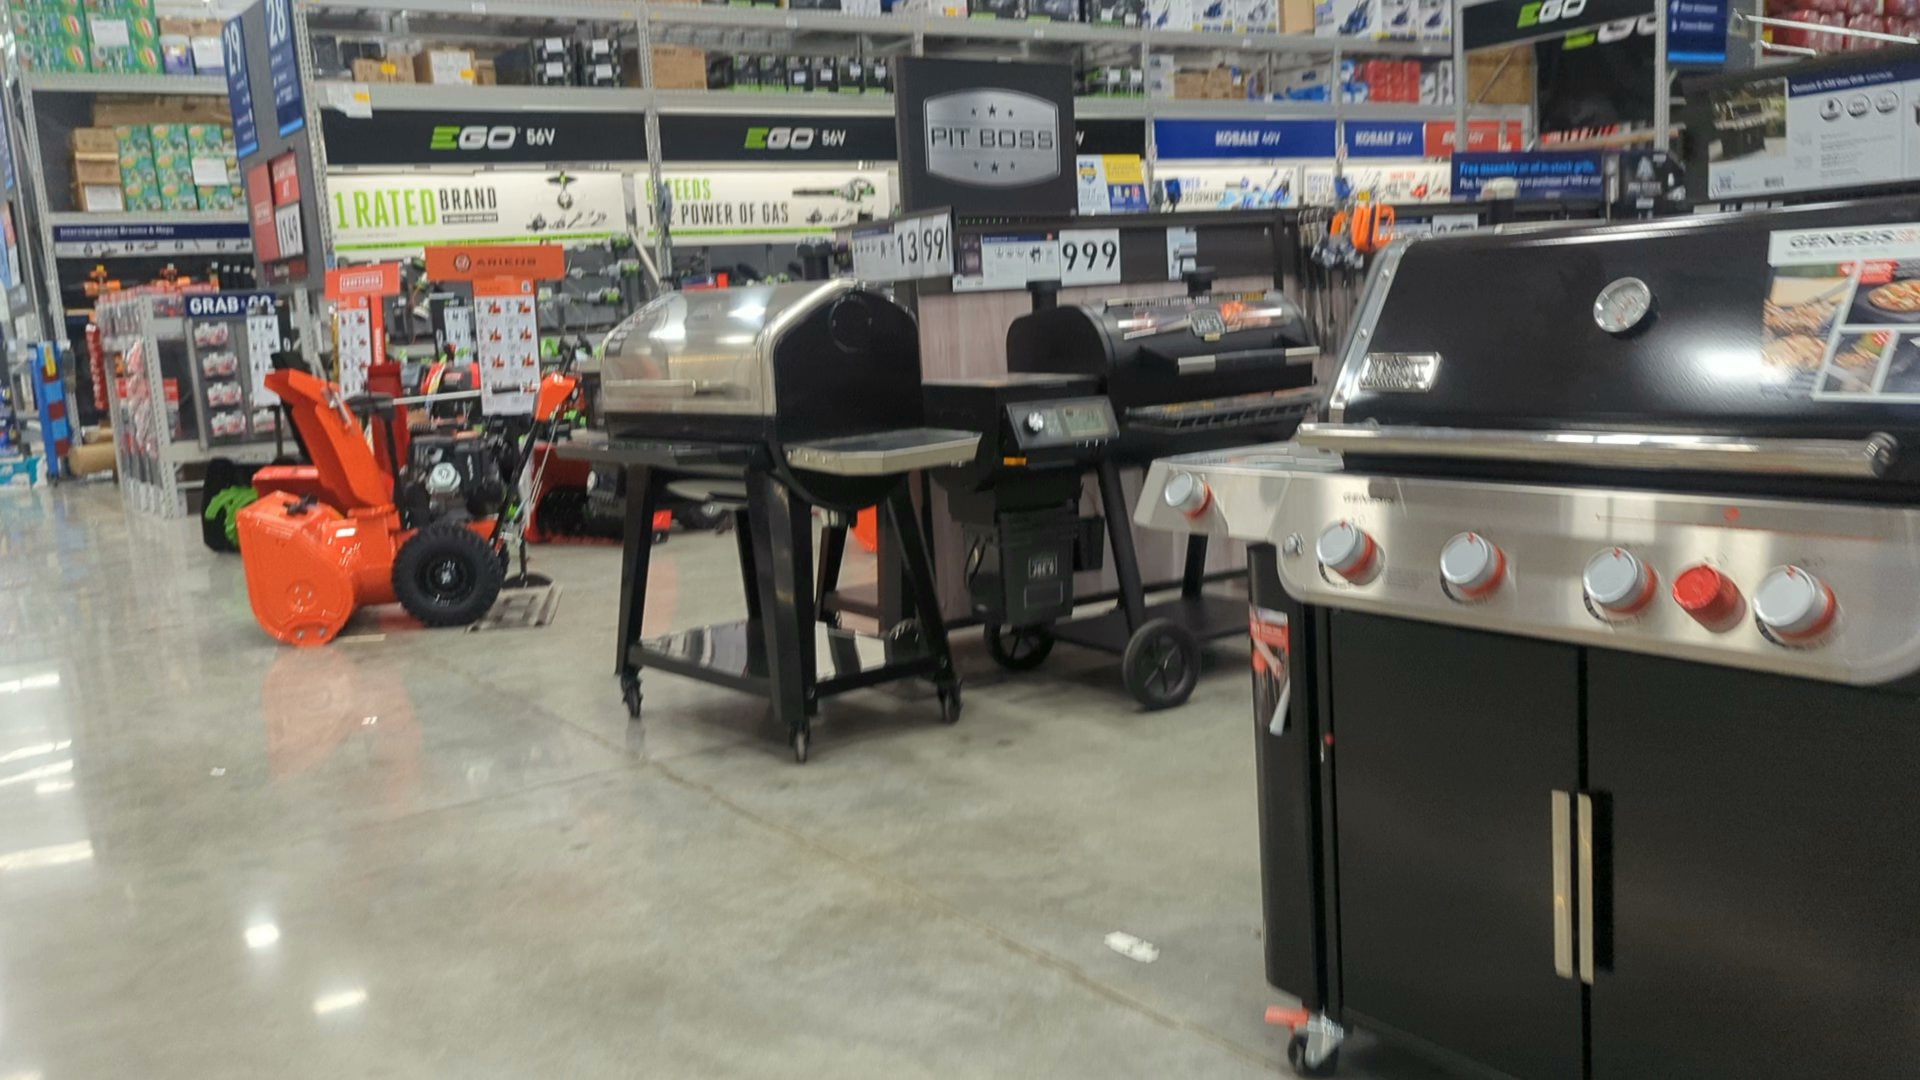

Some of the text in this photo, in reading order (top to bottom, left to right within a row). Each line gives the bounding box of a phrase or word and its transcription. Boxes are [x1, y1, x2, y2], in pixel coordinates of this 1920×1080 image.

[266, 0, 287, 48] 28
[1517, 0, 1588, 28] EGO
[224, 21, 242, 77] 29
[430, 126, 556, 150] EGO 56V
[744, 127, 847, 150] EGO 56V
[931, 127, 970, 149] PIT
[980, 128, 1053, 149] BOSS
[1215, 130, 1260, 147] KOBALT
[1355, 130, 1395, 147] KOBALT
[1460, 161, 1479, 175] Free
[1480, 160, 1518, 176] assembly
[353, 188, 438, 228] RATED
[439, 186, 498, 211] BRAND
[681, 202, 734, 225] POWER
[739, 202, 757, 224] OF
[762, 201, 789, 223] GAS
[1062, 240, 1118, 272] 999
[190, 296, 239, 315] GRAB
